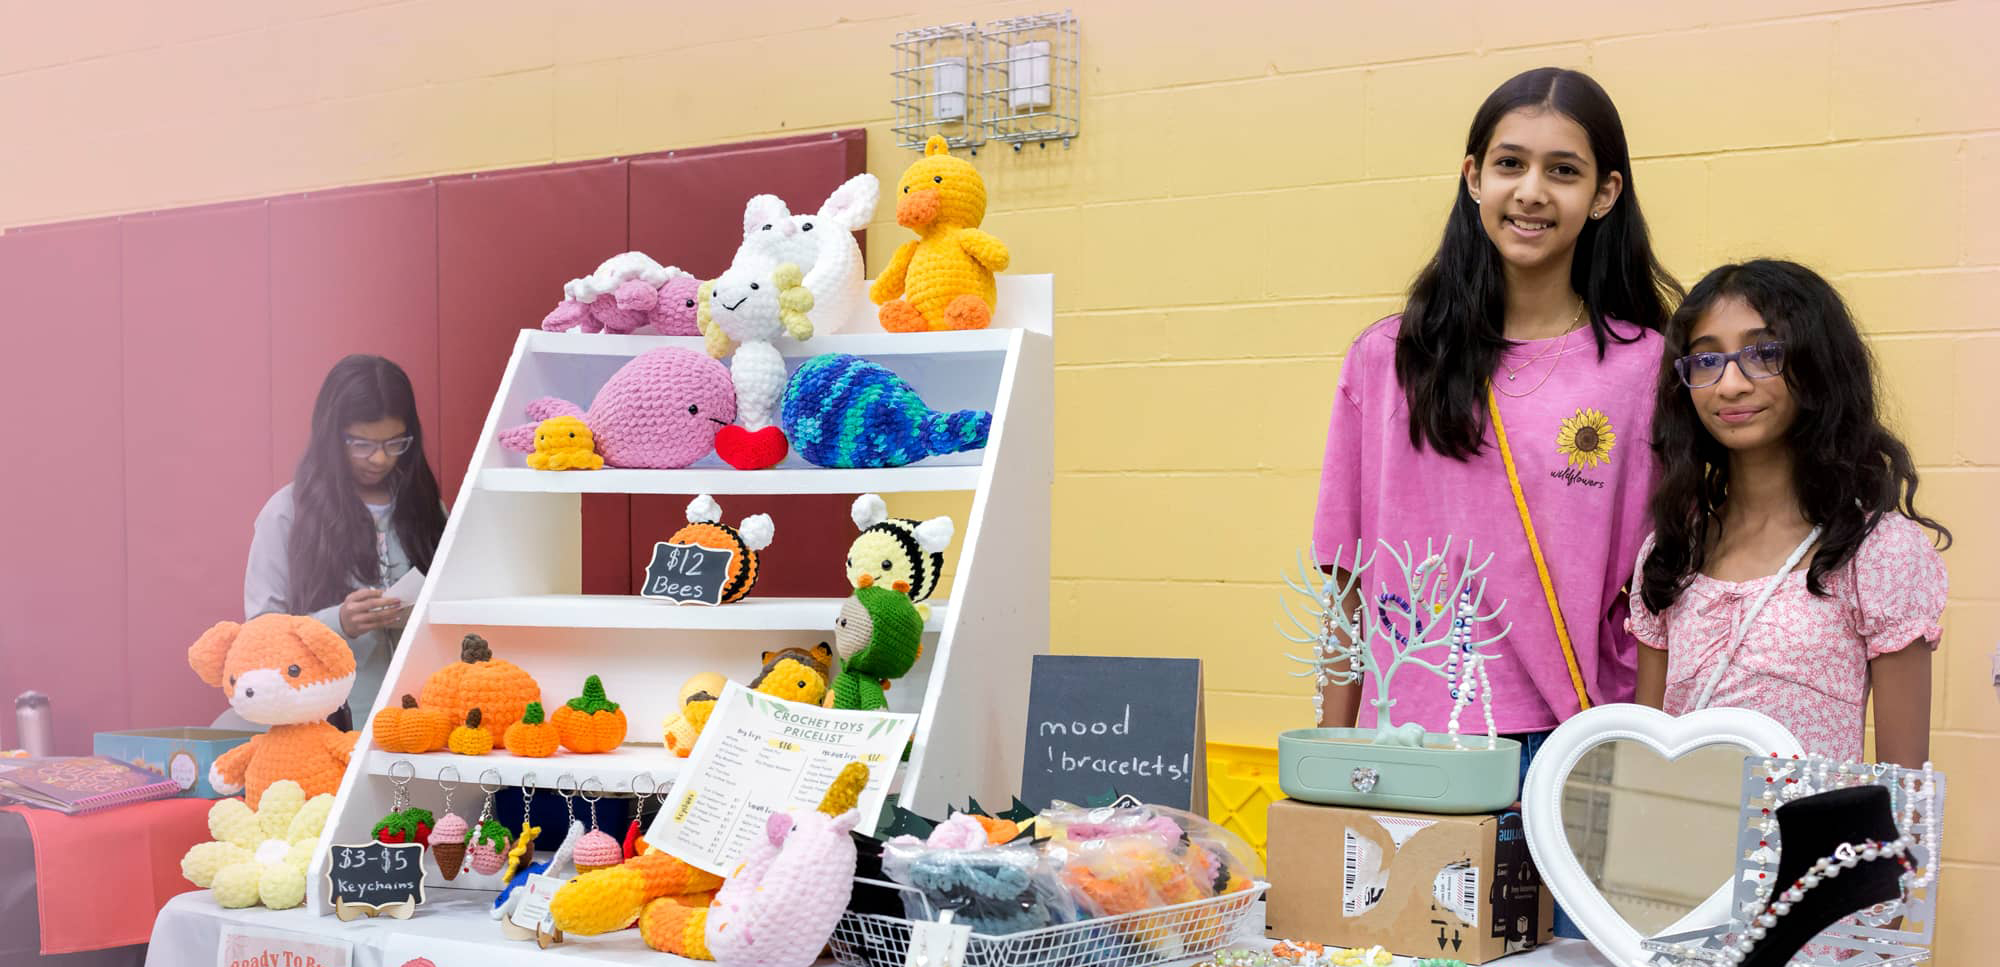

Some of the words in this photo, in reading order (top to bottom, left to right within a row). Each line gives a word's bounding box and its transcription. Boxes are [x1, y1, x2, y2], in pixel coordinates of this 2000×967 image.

[1551, 467, 1605, 488] wildflowers
[667, 547, 704, 576] $12
[652, 576, 704, 598] Bees
[773, 709, 831, 729] CROCHET
[833, 720, 865, 732] TOYS
[1039, 703, 1130, 736] mood
[783, 726, 845, 743] PRICELIST
[337, 878, 415, 898] Keychains
[283, 951, 303, 967] To
